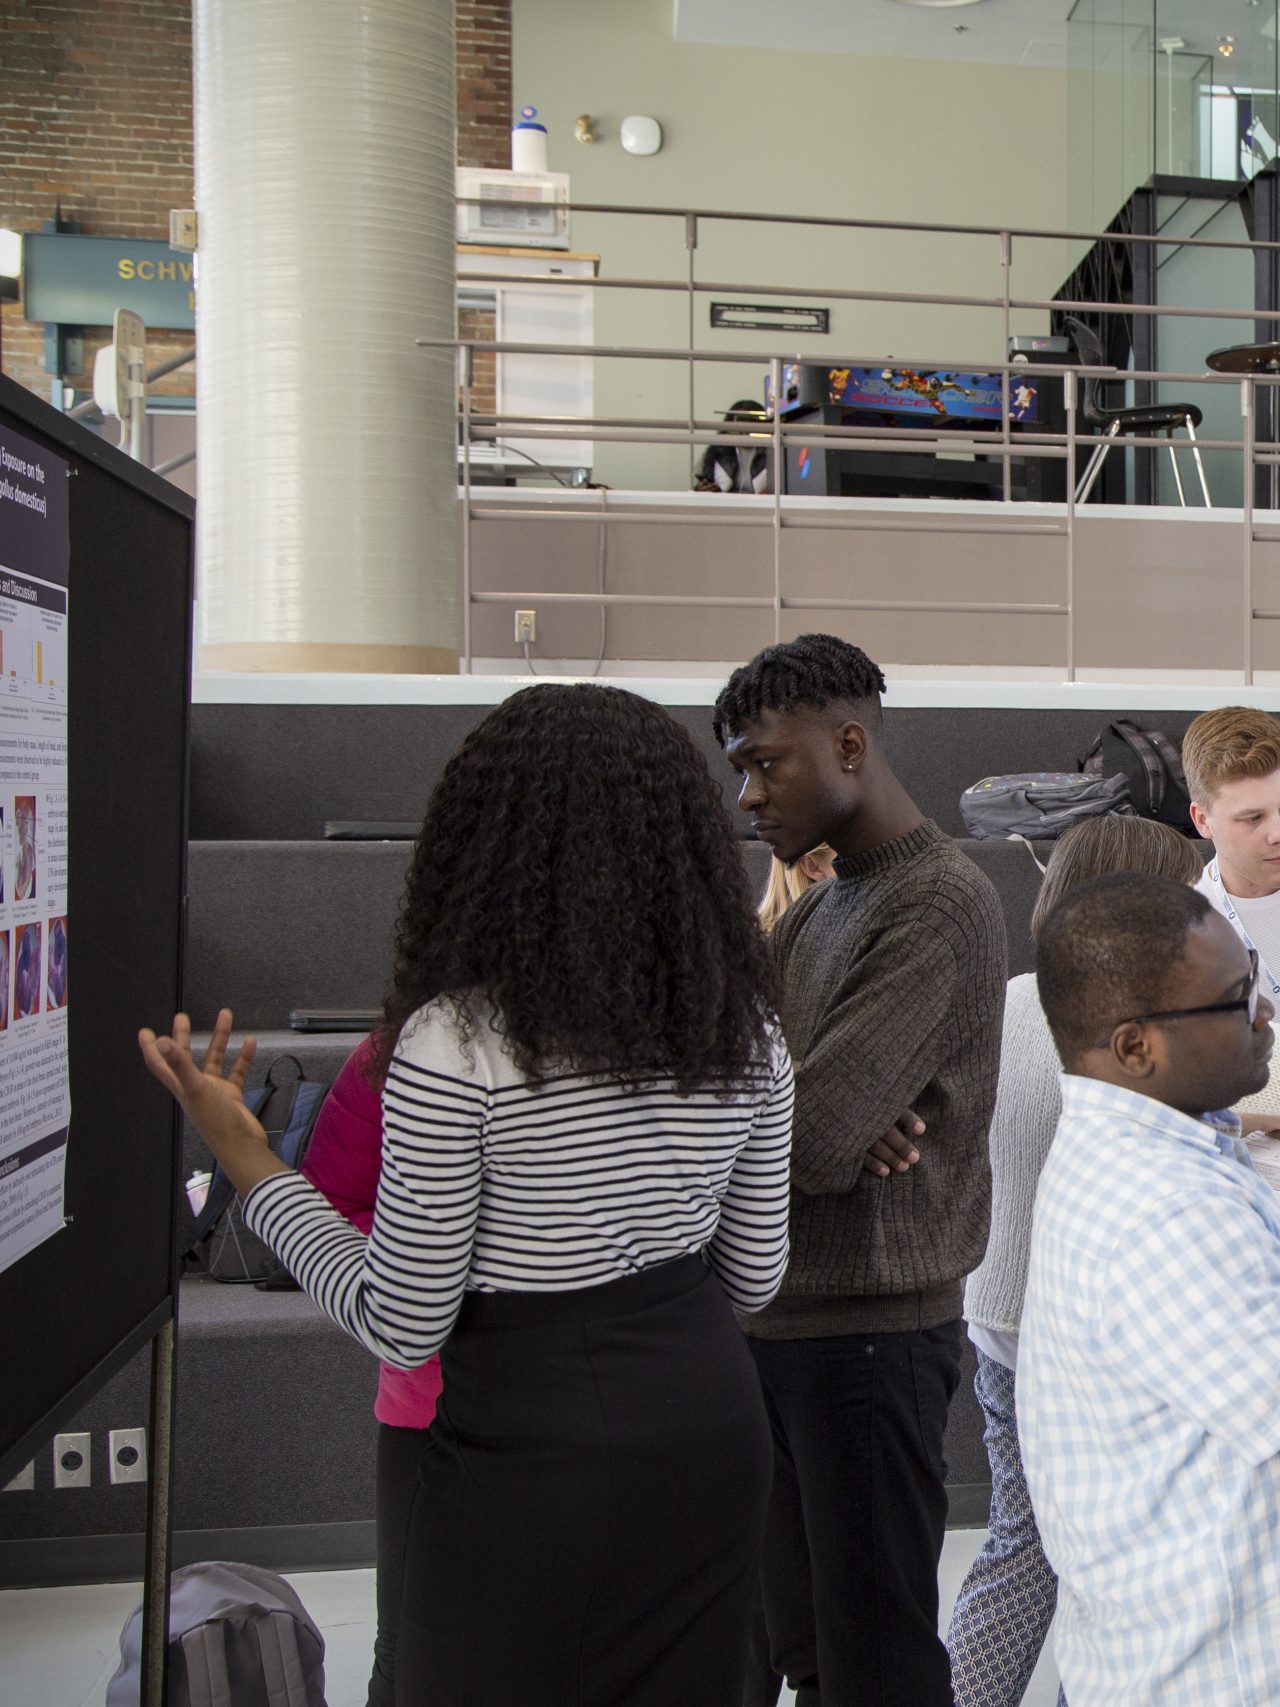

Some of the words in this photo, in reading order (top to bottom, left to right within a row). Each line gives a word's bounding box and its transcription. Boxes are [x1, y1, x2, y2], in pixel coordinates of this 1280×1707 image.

[2, 447, 26, 475] Exposure
[27, 464, 35, 479] on
[36, 464, 44, 484] the
[15, 484, 46, 518] domesticus)
[2, 581, 10, 597] and
[11, 580, 37, 602] Discussion
